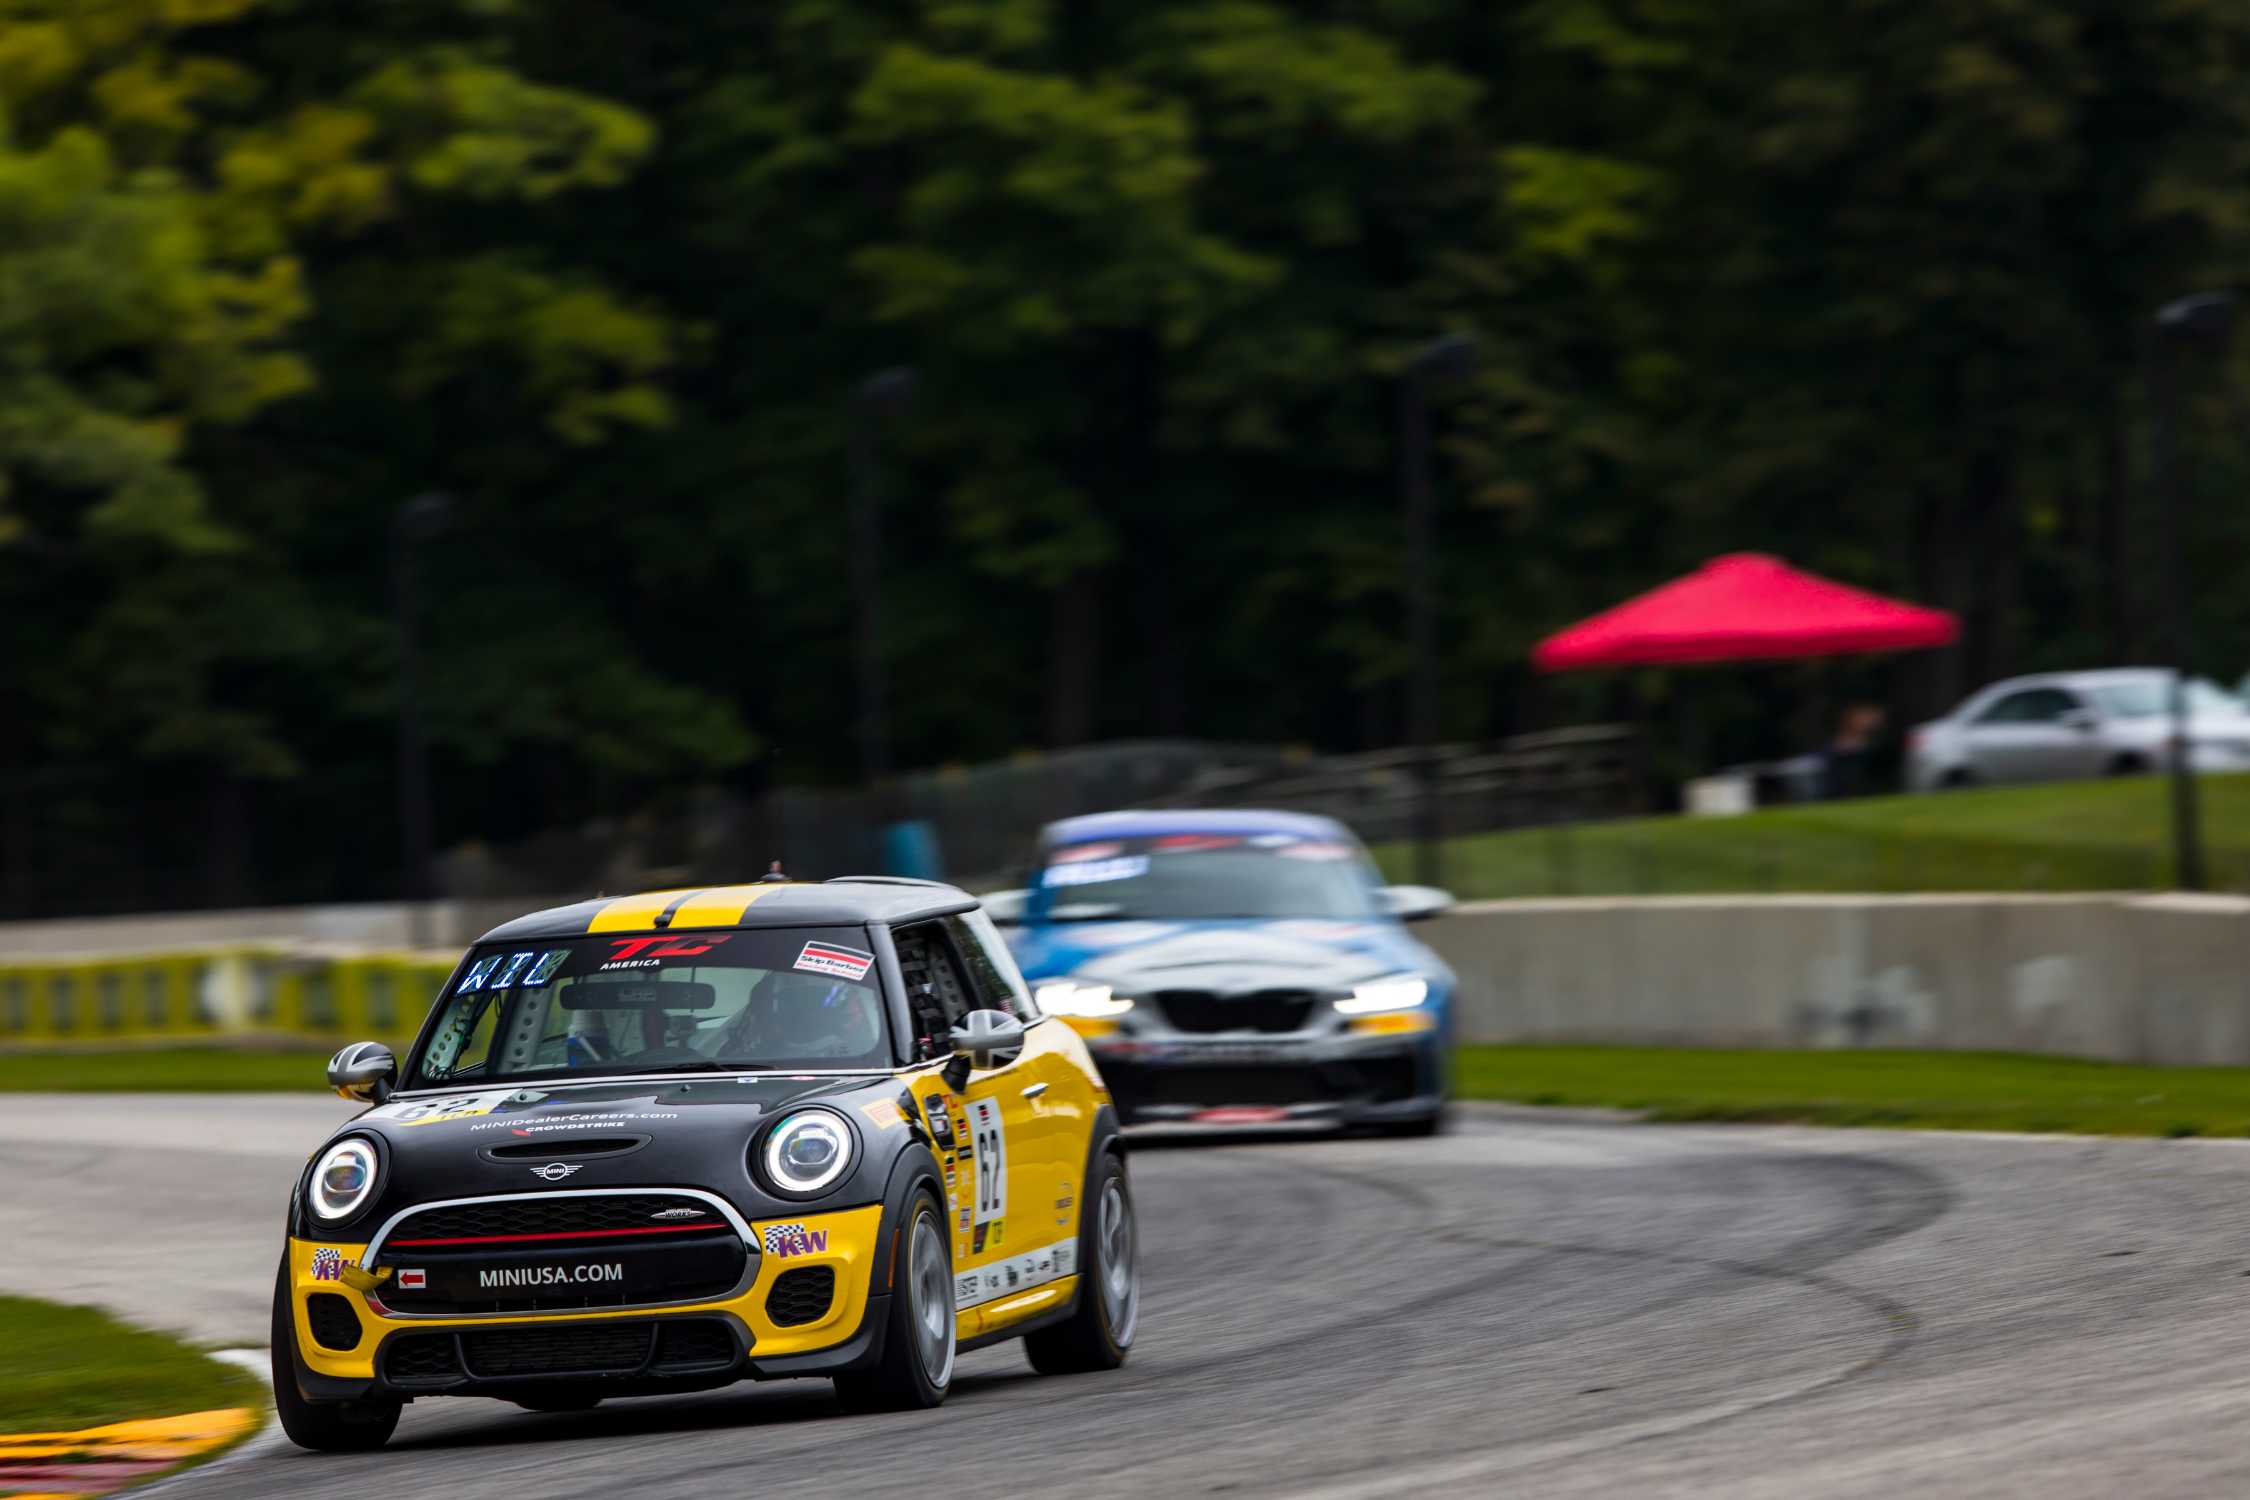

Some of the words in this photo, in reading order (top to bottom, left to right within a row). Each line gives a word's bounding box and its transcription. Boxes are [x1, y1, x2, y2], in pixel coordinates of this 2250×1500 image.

[600, 959, 661, 971] AMERICA
[470, 1112, 679, 1132] MINIDealerCareers.com
[525, 1121, 626, 1133] CROWDSTRIKE
[546, 1167, 566, 1176] MINI
[777, 1229, 828, 1258] KW
[479, 1263, 623, 1288] MINIUSA.COM
